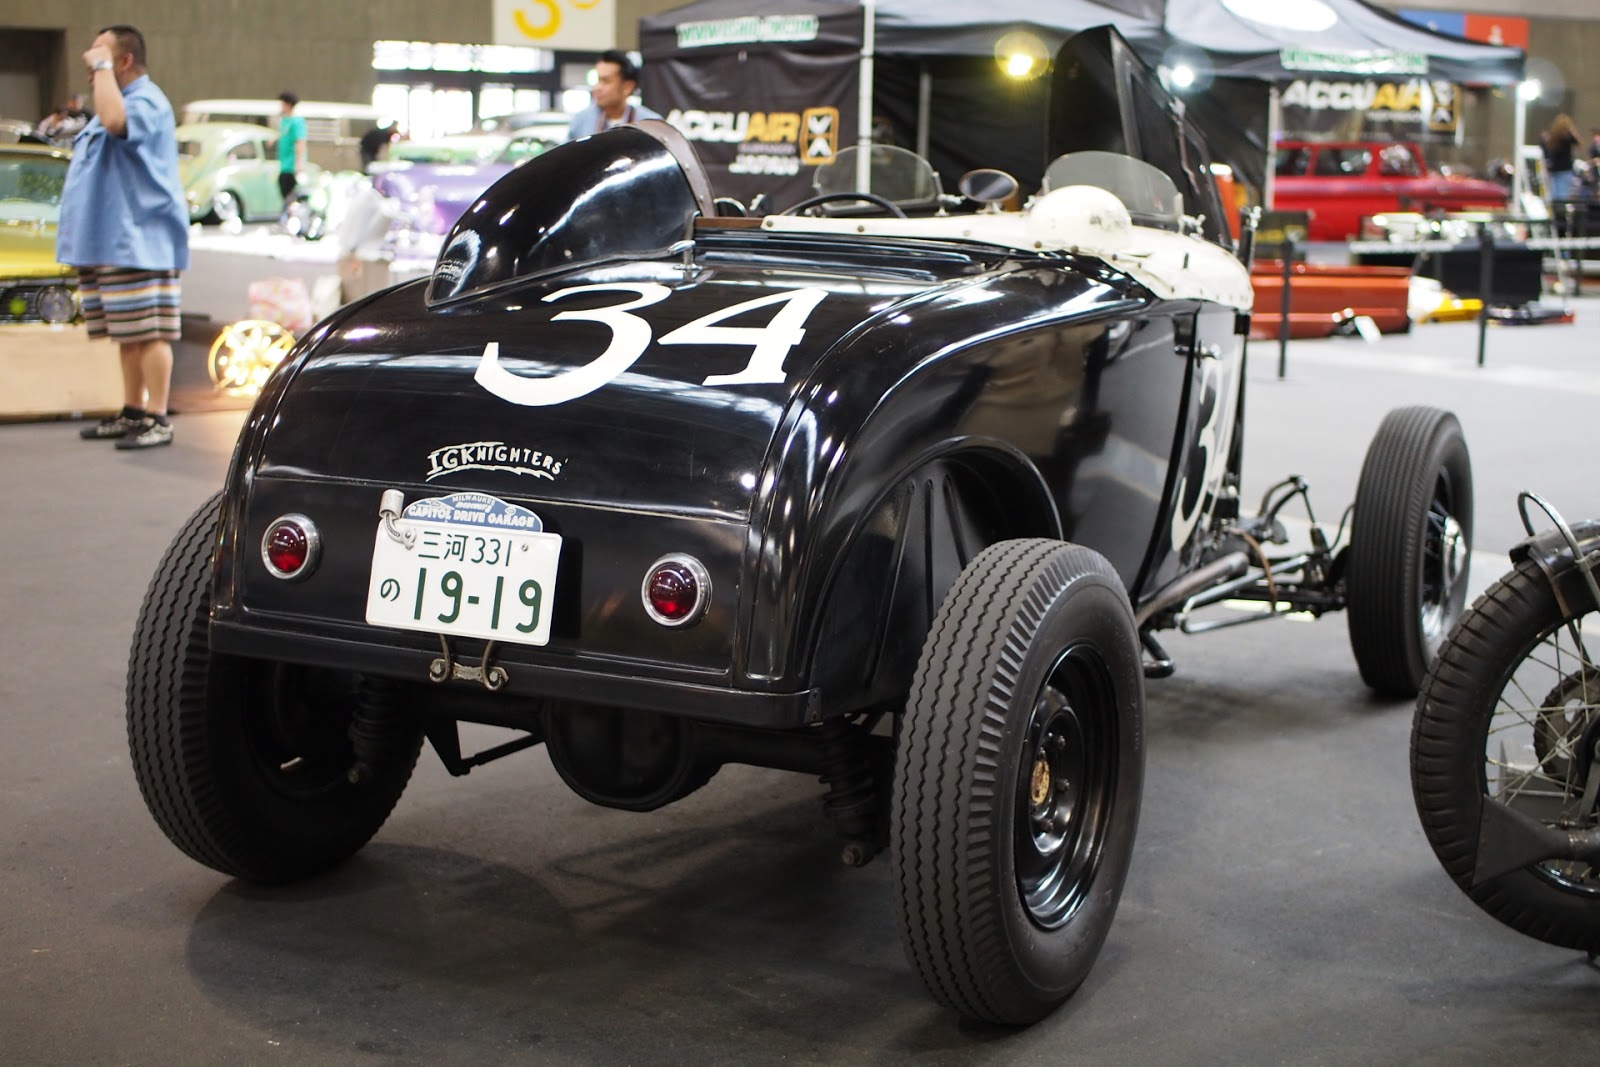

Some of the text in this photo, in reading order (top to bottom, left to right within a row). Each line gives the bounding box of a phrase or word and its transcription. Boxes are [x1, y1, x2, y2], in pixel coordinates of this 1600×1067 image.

[474, 282, 829, 407] 34
[408, 505, 452, 520] CAPITOL
[453, 509, 486, 524] DRIVE
[487, 512, 535, 528] GARAGE
[380, 567, 543, 633] の 19-19
